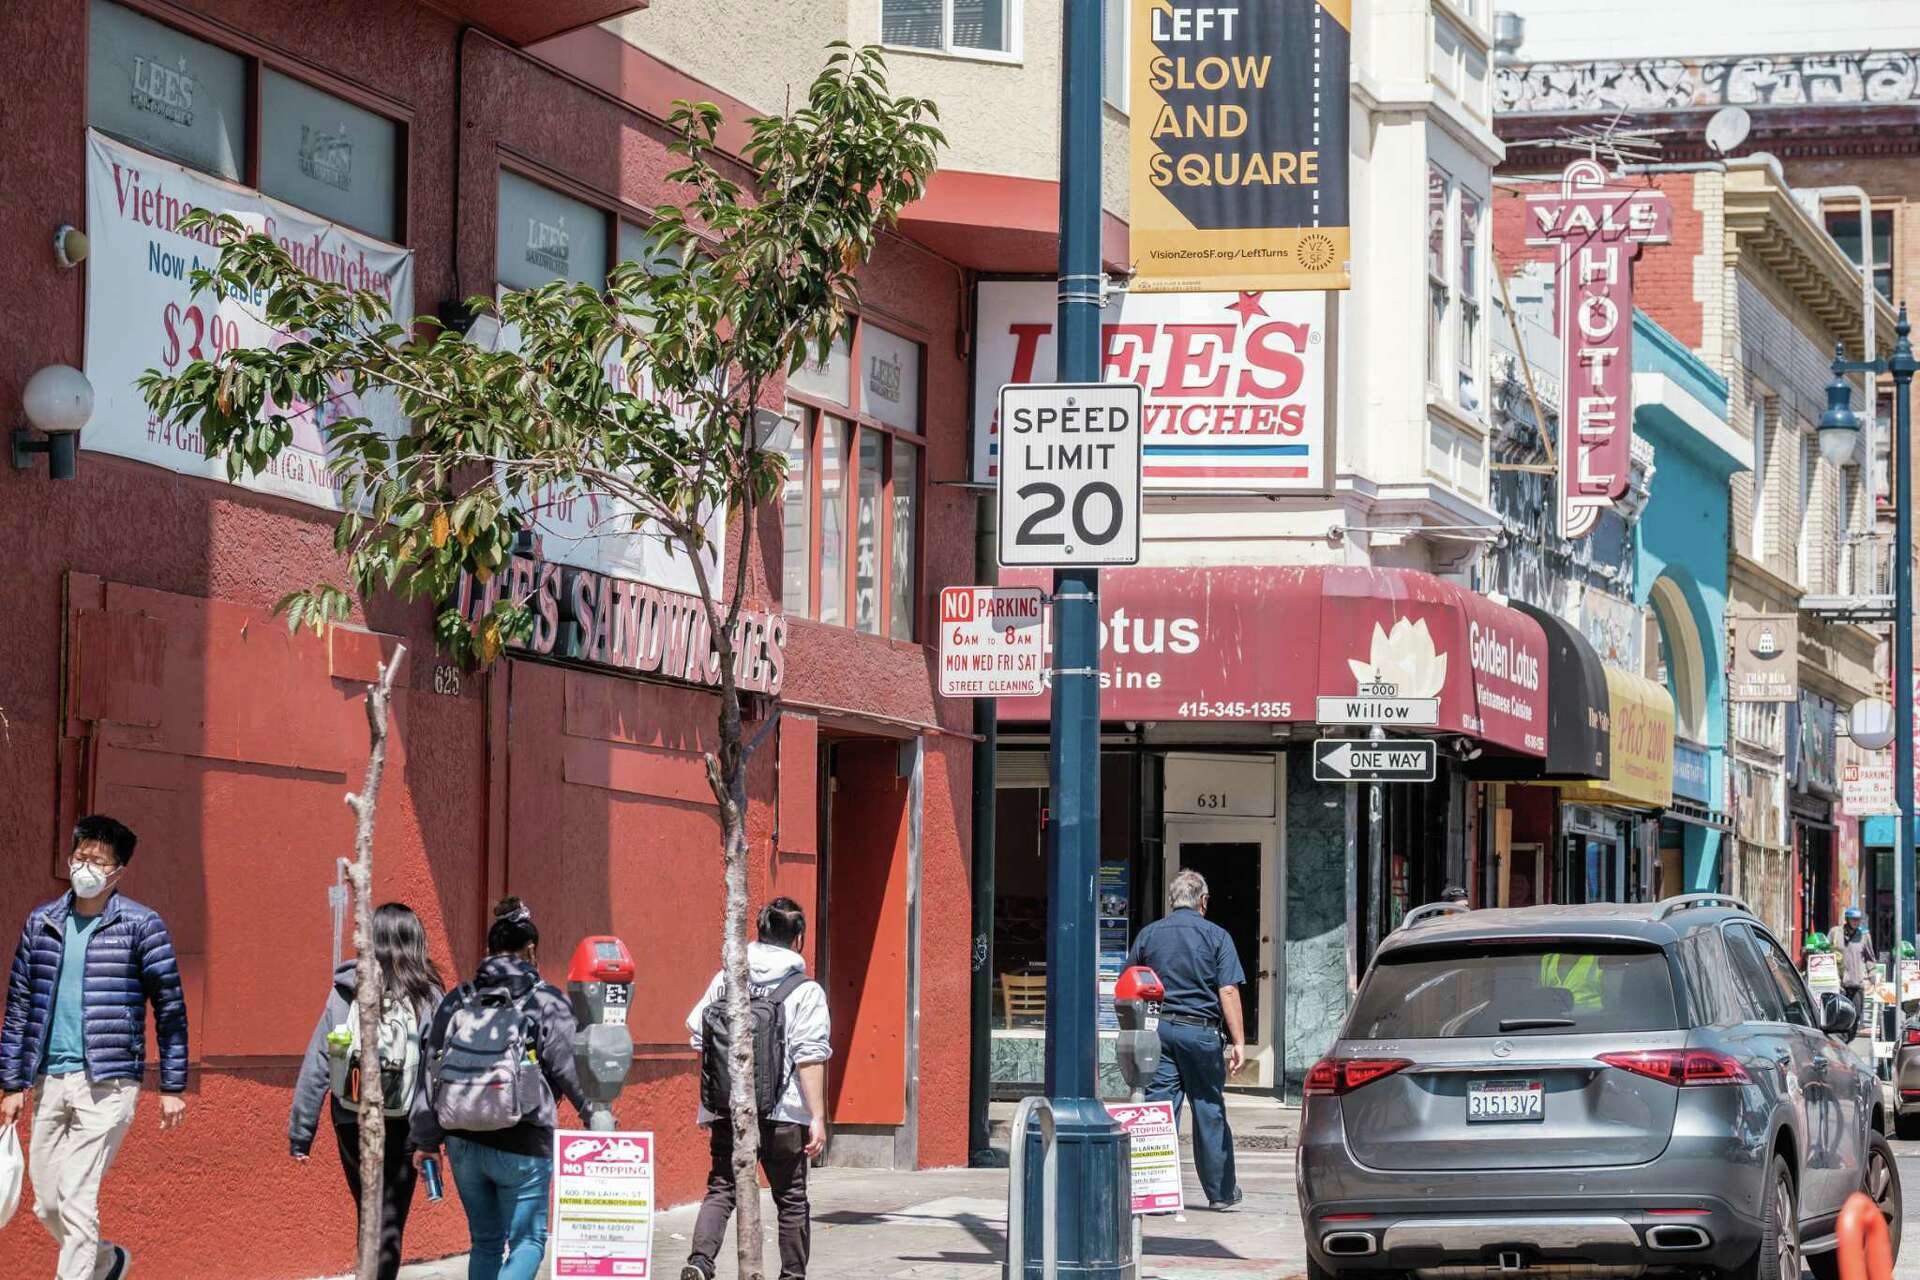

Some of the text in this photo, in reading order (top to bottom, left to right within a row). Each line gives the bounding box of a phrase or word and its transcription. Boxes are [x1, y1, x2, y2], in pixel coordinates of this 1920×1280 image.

[1152, 7, 1239, 42] LEFT
[1150, 55, 1272, 91] SLOW
[1151, 104, 1248, 138] AND
[1149, 151, 1319, 187] SQUARE
[112, 163, 255, 247] Vietnam
[1532, 204, 1658, 232] YALE
[149, 241, 184, 279] Now
[1150, 248, 1289, 262] VisionZeroSF.org/LeftTurns
[1577, 246, 1619, 487] HOTEL
[1013, 407, 1130, 433] SPEED
[1025, 444, 1116, 470] LIMIT
[1015, 481, 1124, 546] 20
[945, 591, 1038, 618] NO PARKING
[953, 627, 978, 646] 6AM
[1005, 625, 1032, 645] 8AM
[946, 654, 1037, 671] MON WED FRI SAT
[1470, 621, 1538, 691] Golden Lotus
[434, 665, 460, 696] 625
[949, 679, 1034, 692] STREET CLEANING
[1178, 701, 1292, 718] 415-345-1355
[1347, 703, 1409, 719] Willow
[1351, 753, 1421, 768] ONE WAY
[1845, 768, 1889, 780] NO PARKING
[1197, 794, 1228, 808] 631
[1131, 1126, 1172, 1135] STOPPING
[563, 1163, 646, 1176] NO STOPPING
